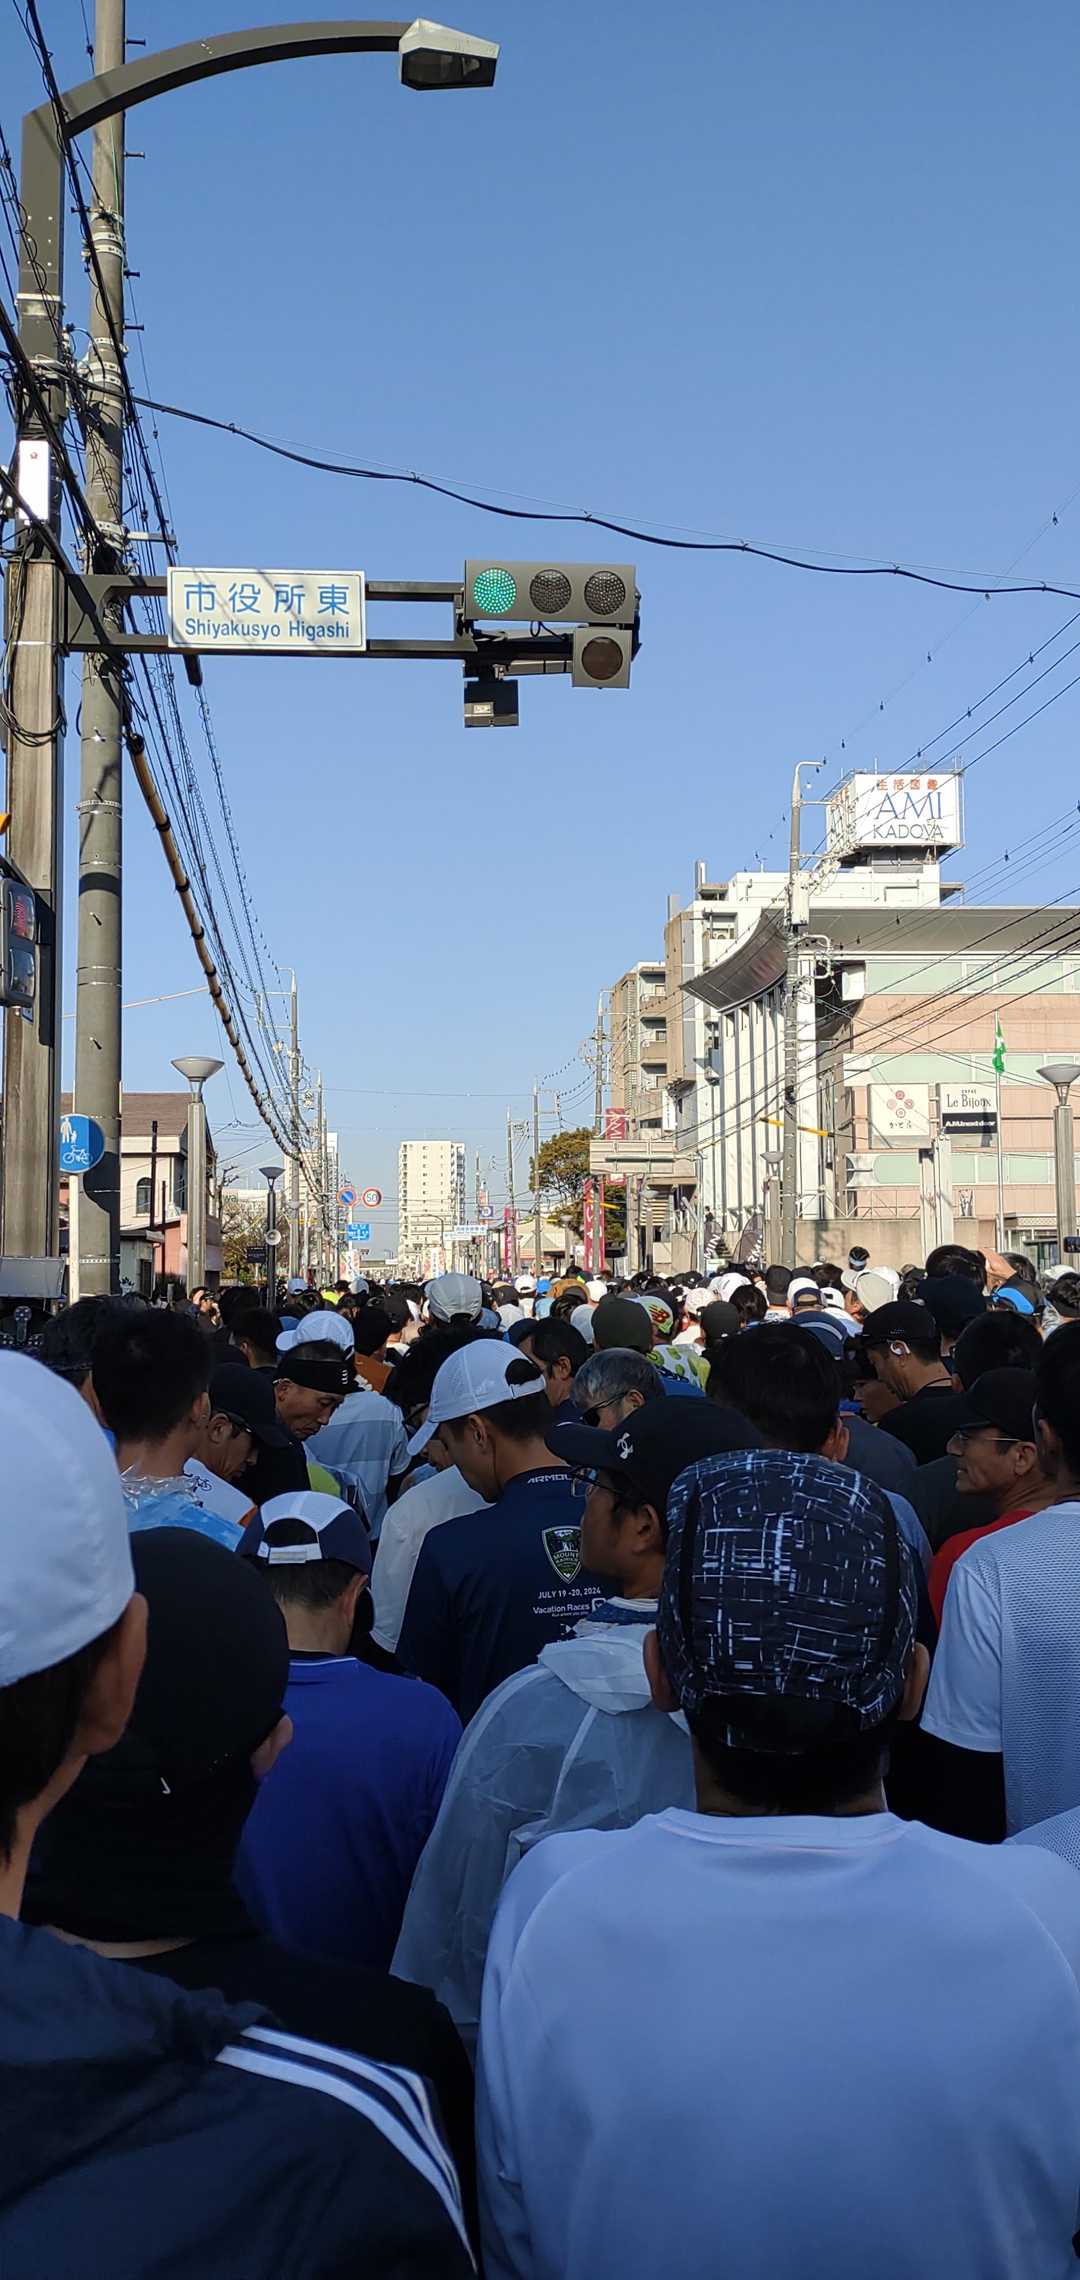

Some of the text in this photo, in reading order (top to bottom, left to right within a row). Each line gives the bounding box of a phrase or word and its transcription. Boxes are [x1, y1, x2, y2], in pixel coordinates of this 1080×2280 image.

[184, 582, 350, 615] 市役所東
[185, 618, 350, 641] Shiyakusyo Higashi
[874, 791, 943, 820] AMI
[873, 823, 945, 839] KADOYA
[946, 1093, 959, 1108] Le
[538, 1590, 557, 1599] JULY
[559, 1589, 567, 1598] 19
[584, 1587, 601, 1595] 2024
[532, 1603, 591, 1614] Vacation Races
